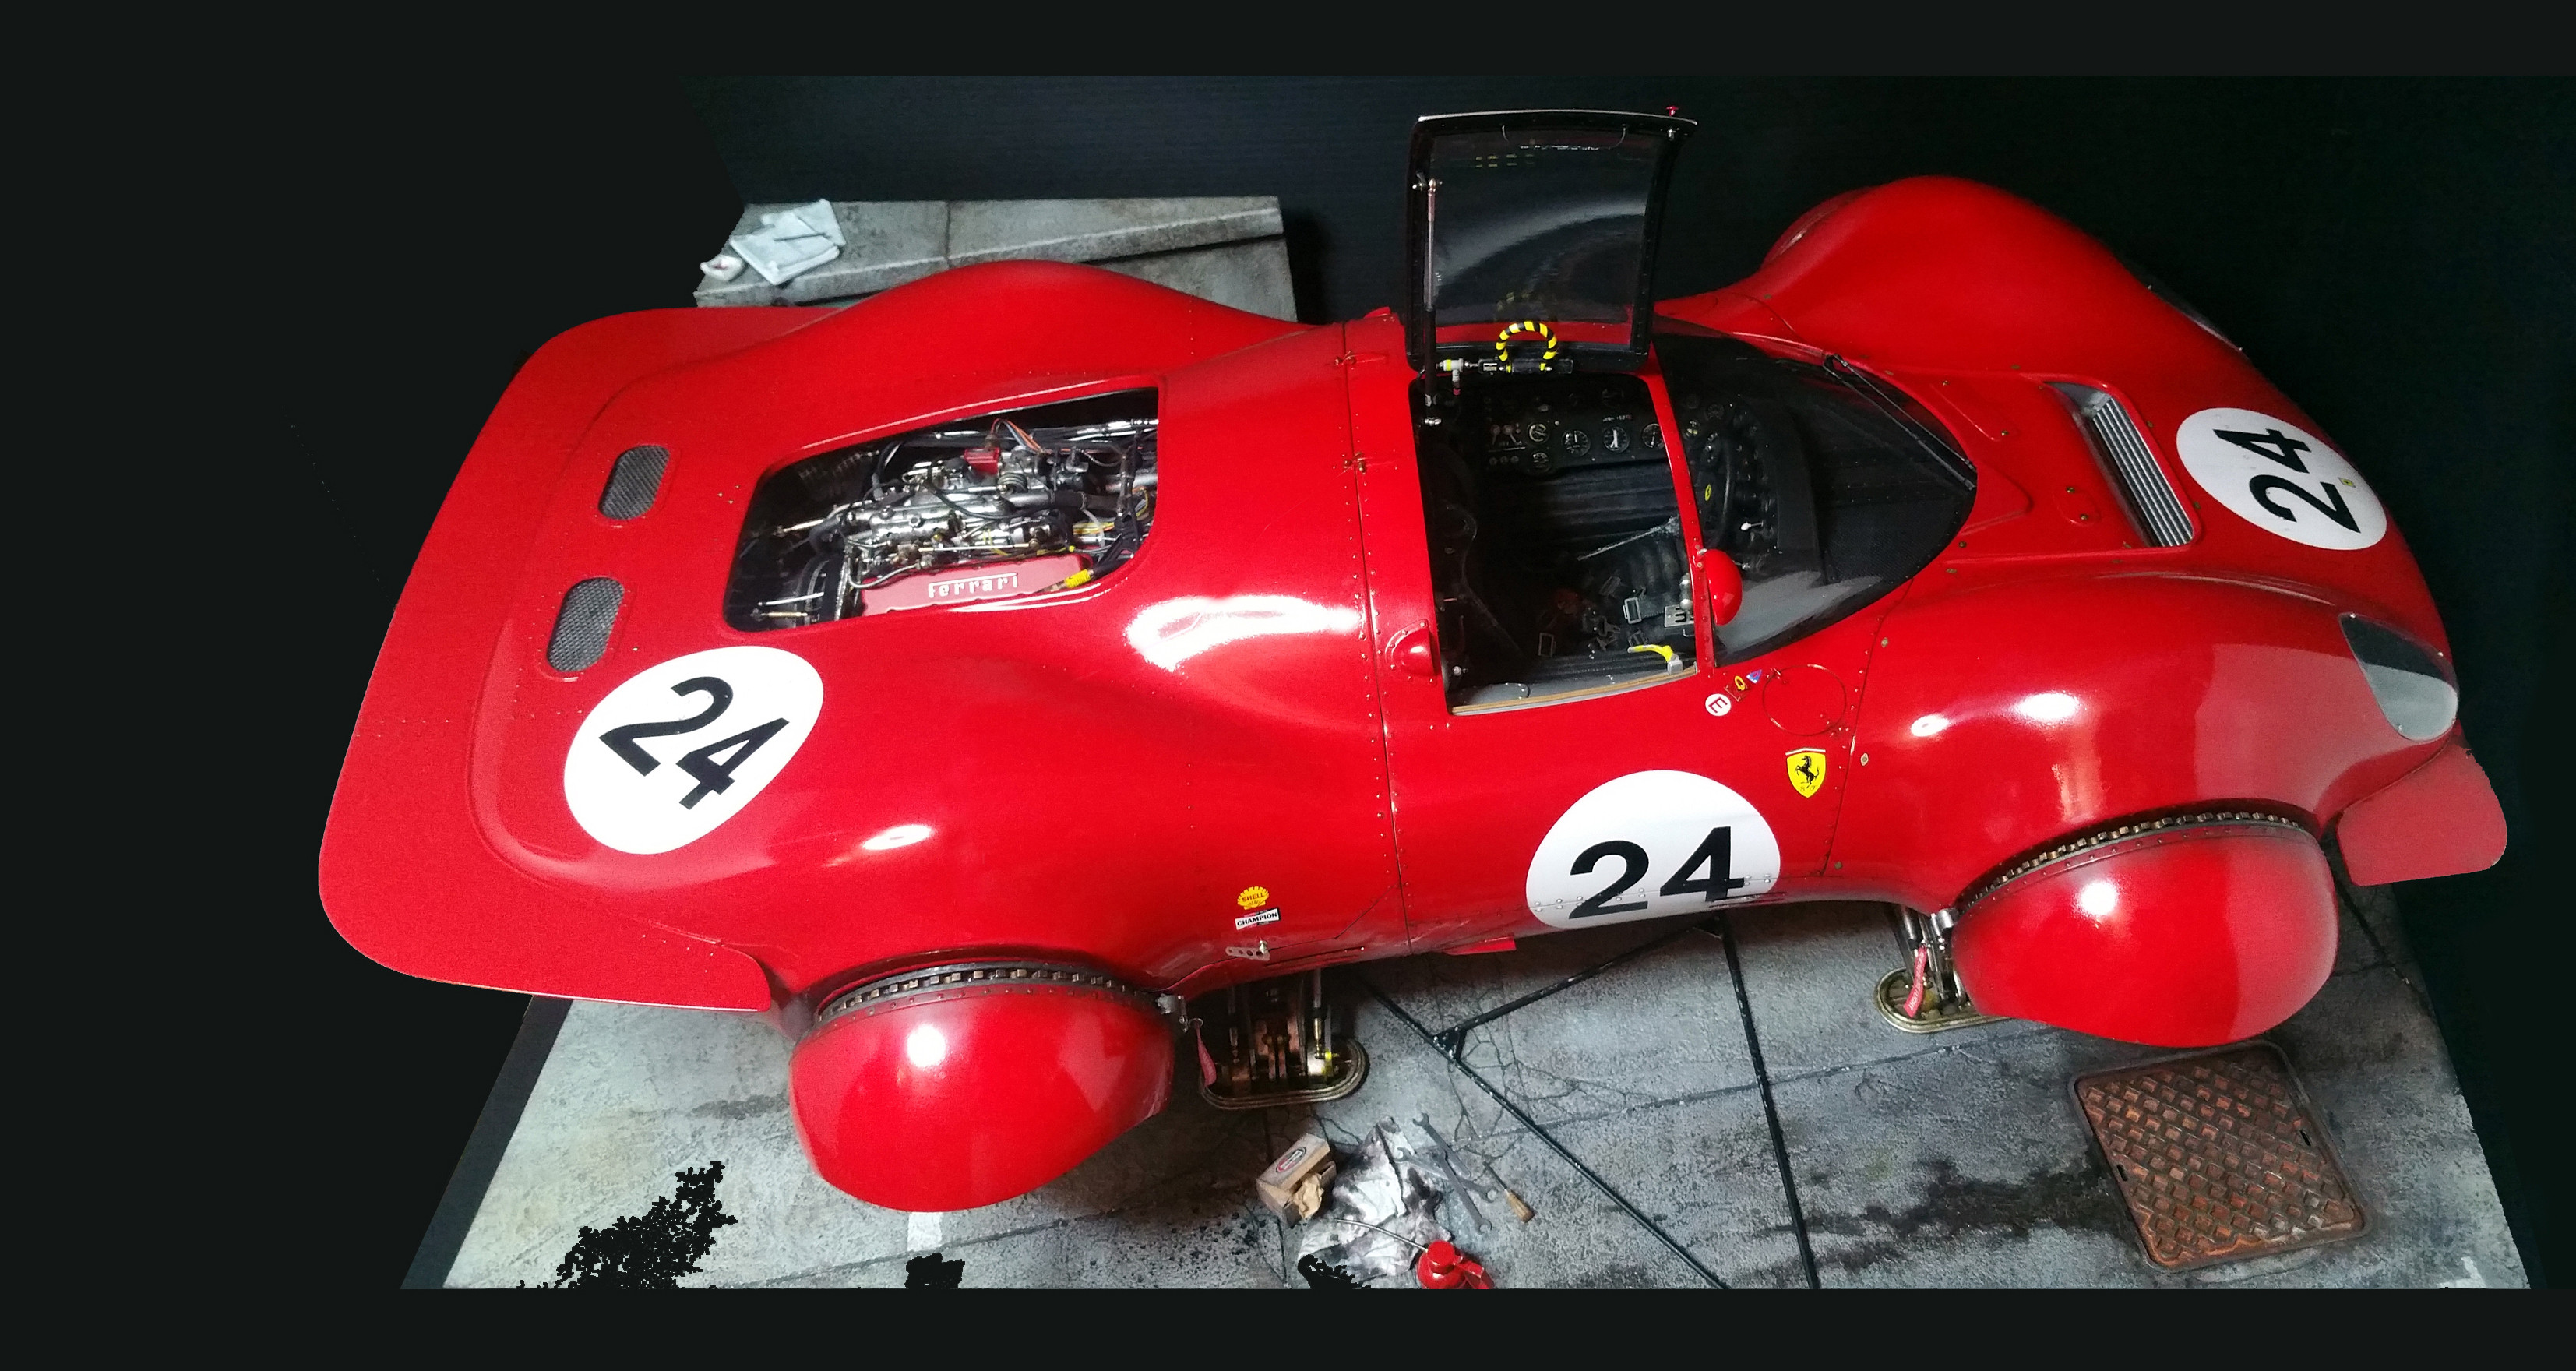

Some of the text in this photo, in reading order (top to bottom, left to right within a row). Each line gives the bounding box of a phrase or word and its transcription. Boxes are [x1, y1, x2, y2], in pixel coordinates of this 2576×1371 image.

[2212, 428, 2362, 534] 24
[928, 573, 1018, 599] Ferrari
[1708, 696, 1728, 714] E
[598, 676, 790, 811] 24
[1568, 826, 1745, 920] 24
[1242, 893, 1265, 902] SHELL
[1237, 912, 1277, 926] CHAMPION
